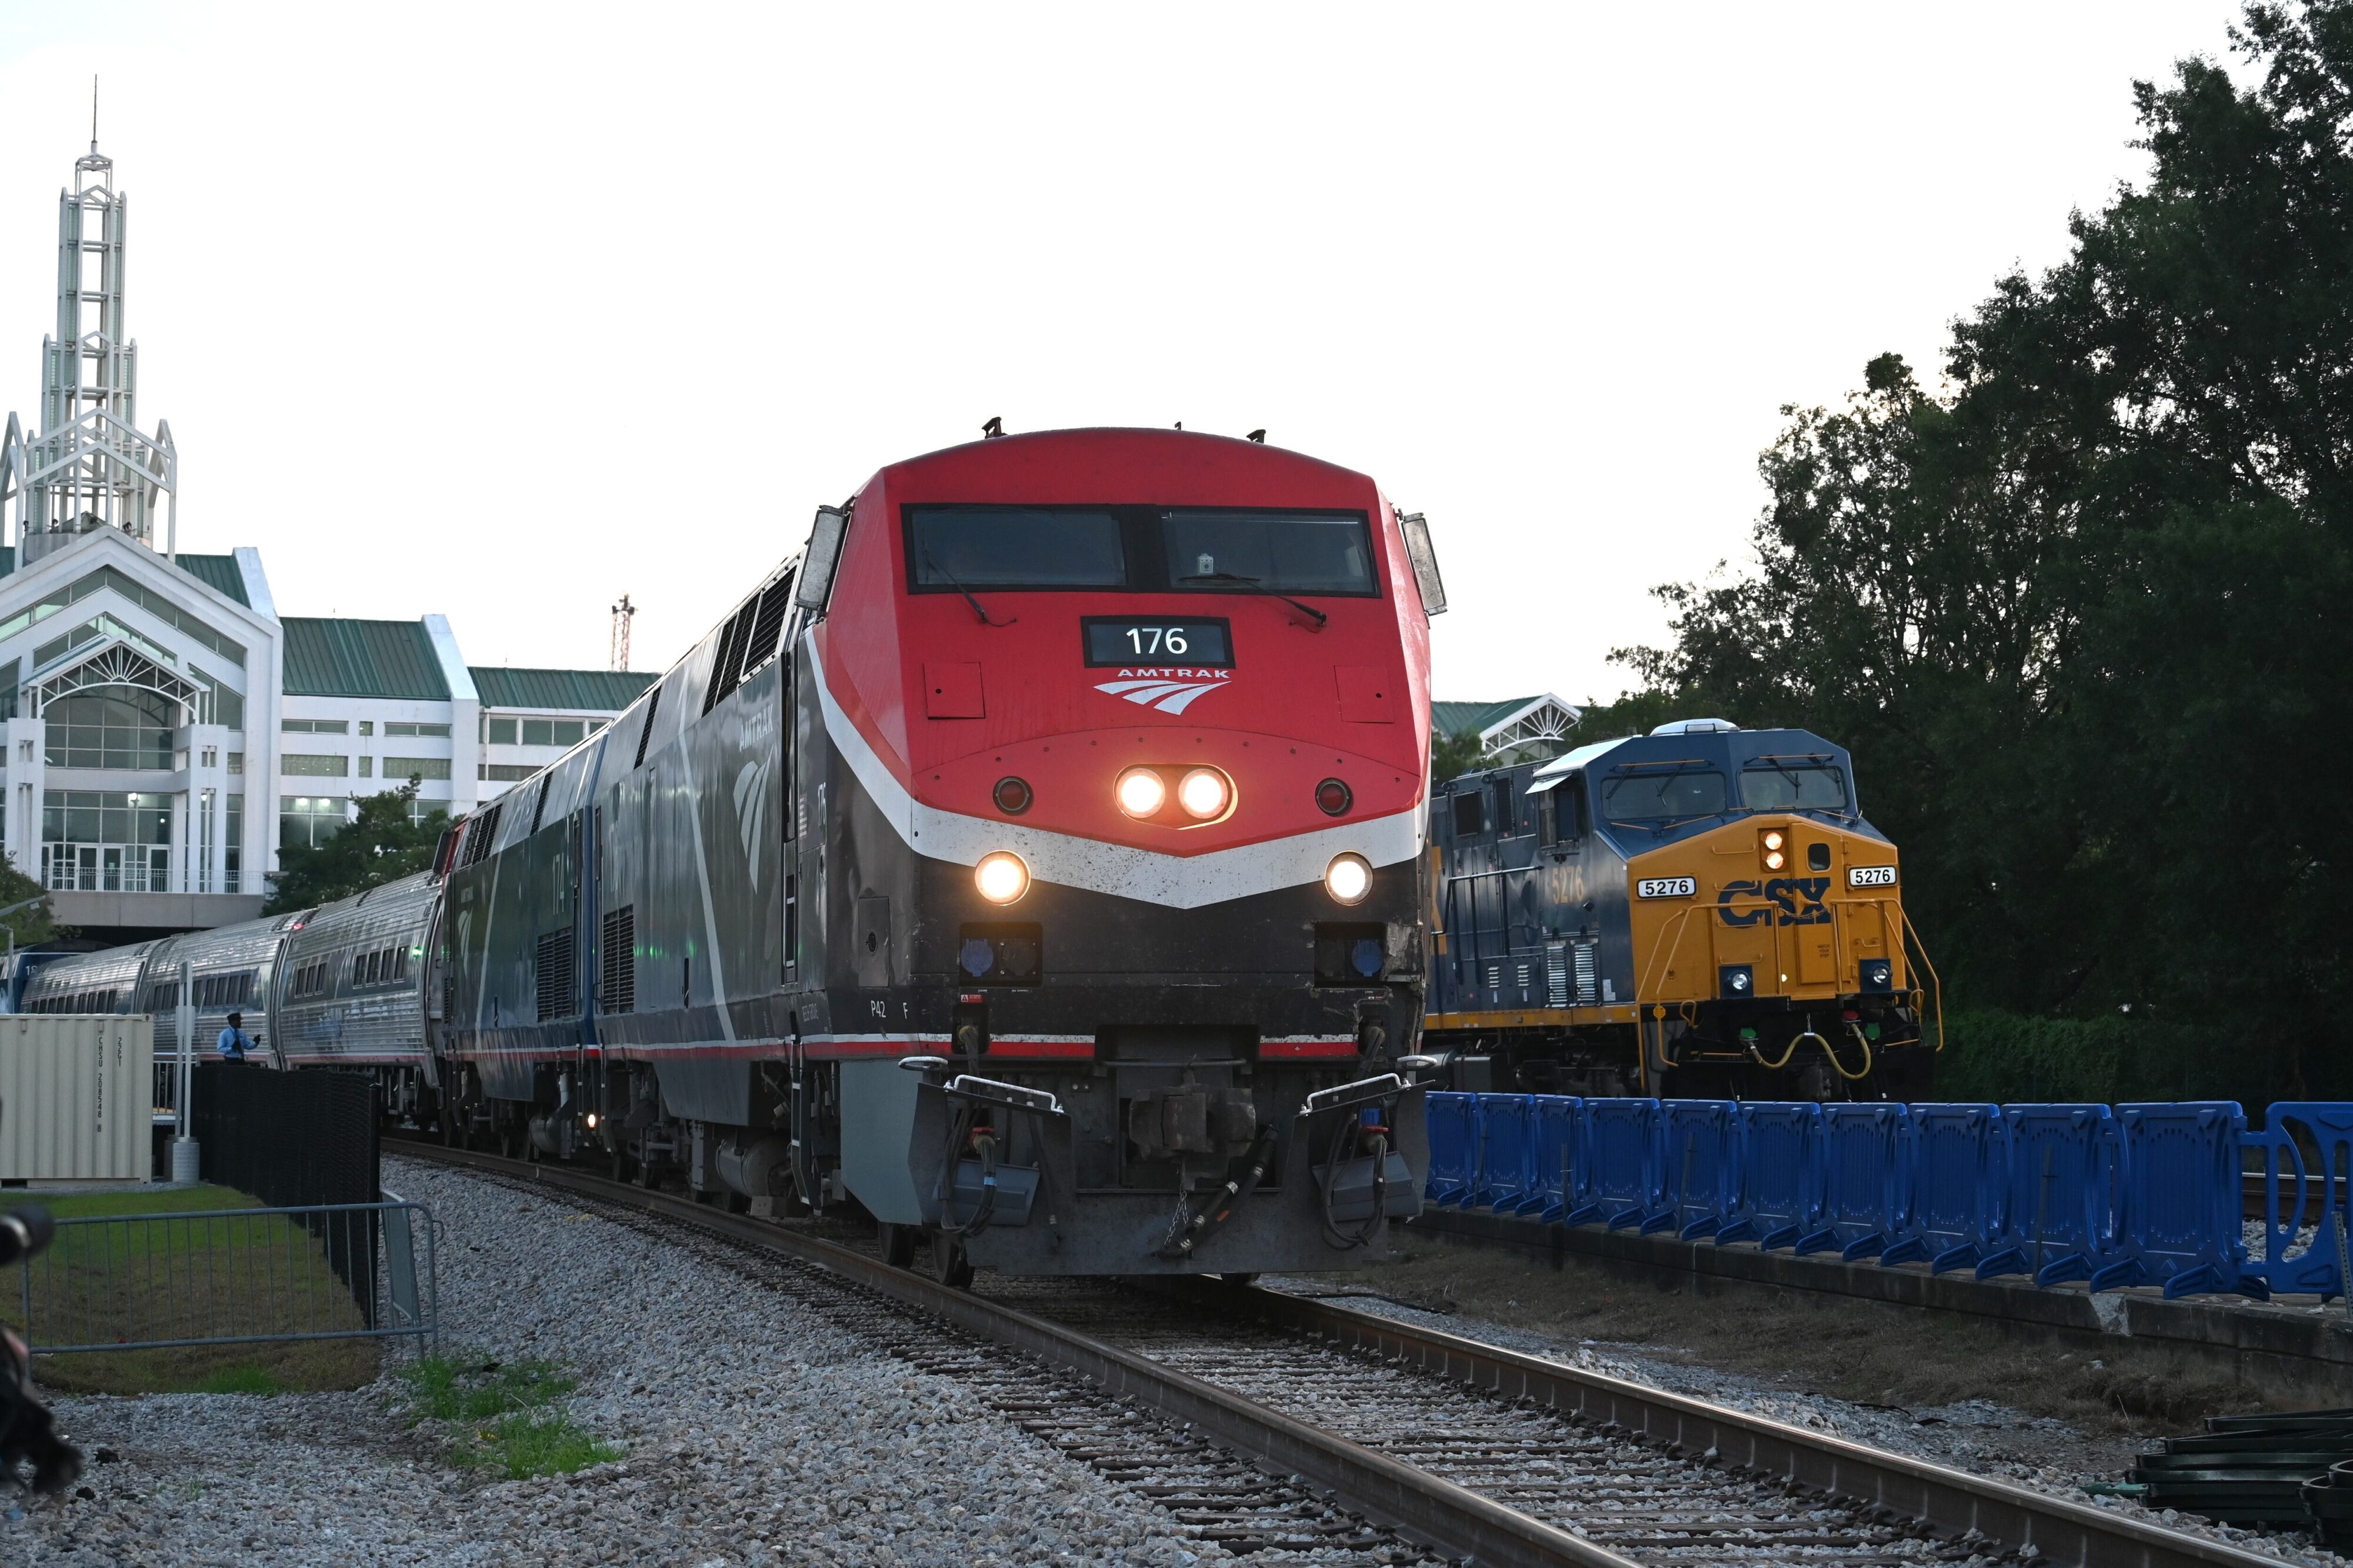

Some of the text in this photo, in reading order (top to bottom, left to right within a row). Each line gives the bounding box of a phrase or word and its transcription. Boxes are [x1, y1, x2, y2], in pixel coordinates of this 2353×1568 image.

[1126, 628, 1188, 654] 176
[1118, 669, 1230, 678] AMTRAK
[739, 703, 774, 752] AMTRAK
[1552, 865, 1584, 904] 5276
[1855, 869, 1890, 883] 5276
[1645, 880, 1688, 895] 5276
[1718, 877, 1832, 929] CSX
[871, 1000, 908, 1019] P42 F
[98, 1124, 102, 1132] 8
